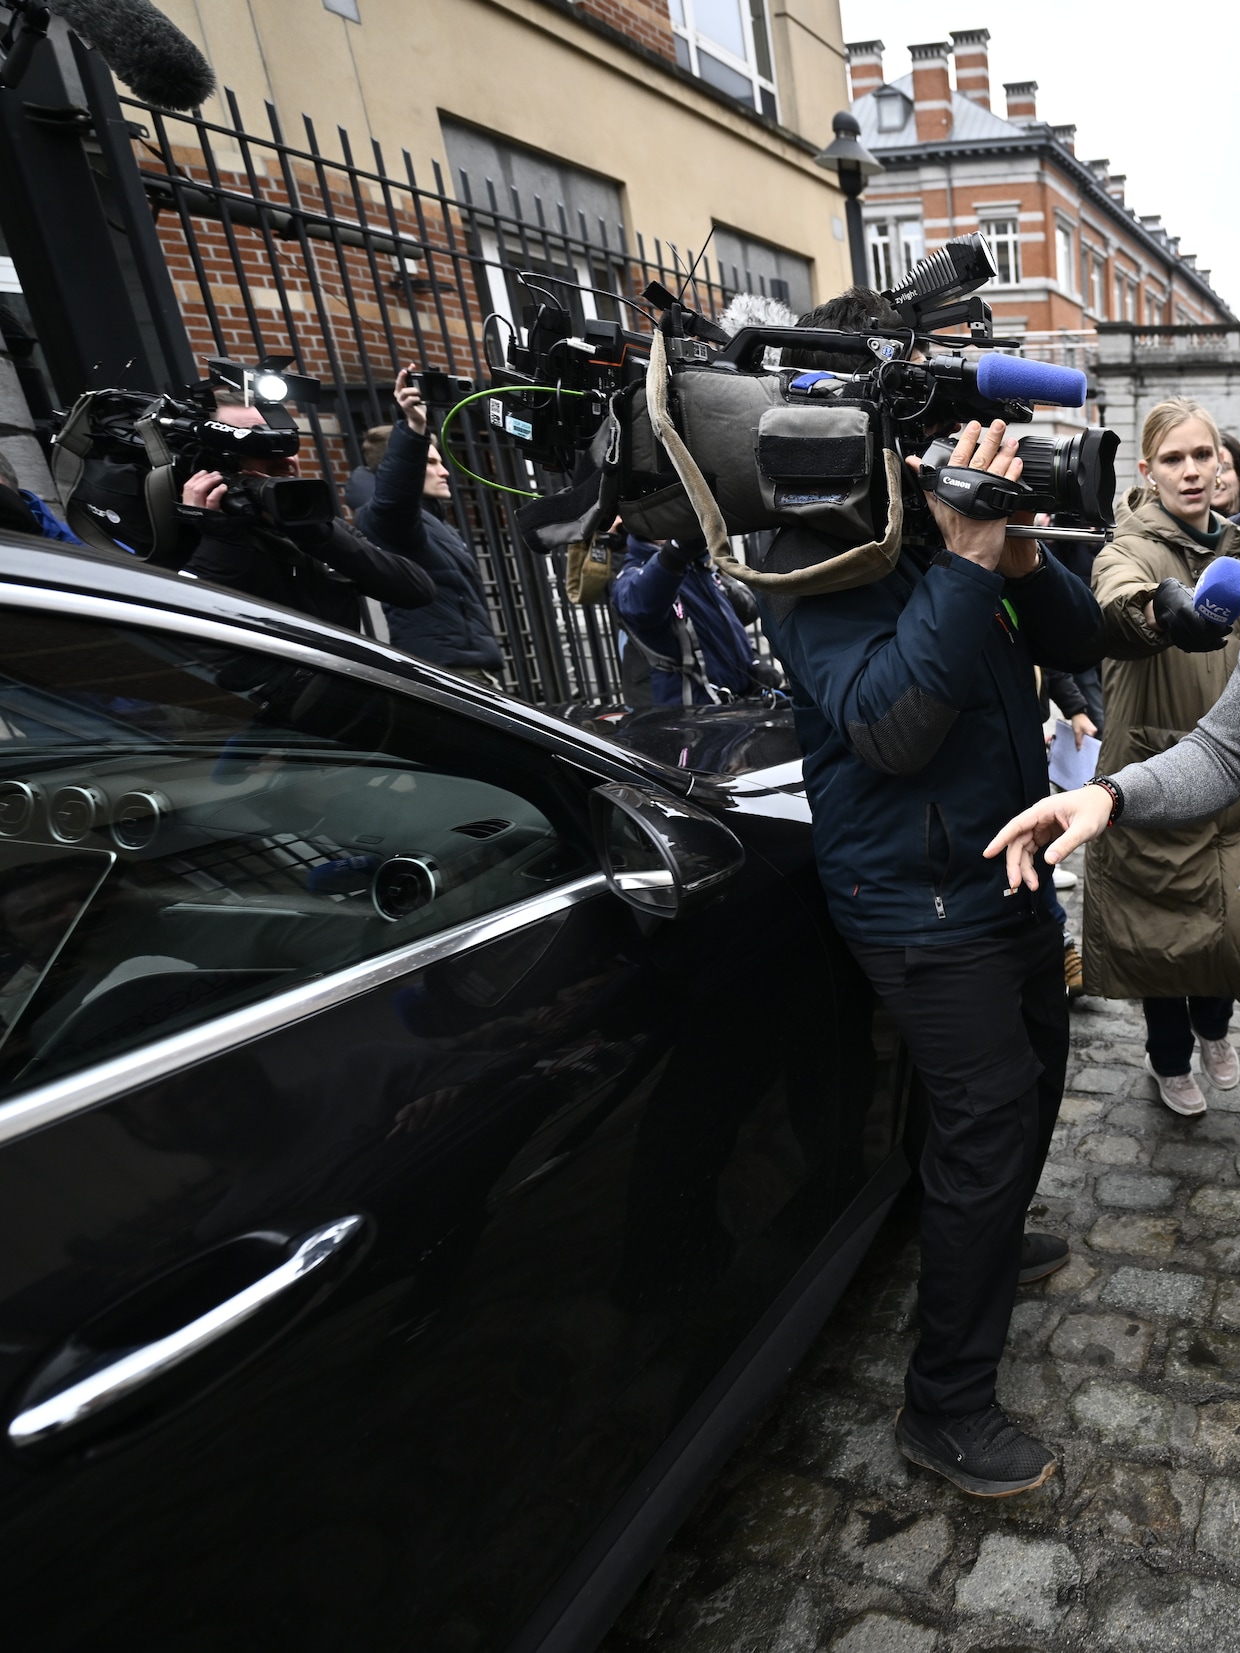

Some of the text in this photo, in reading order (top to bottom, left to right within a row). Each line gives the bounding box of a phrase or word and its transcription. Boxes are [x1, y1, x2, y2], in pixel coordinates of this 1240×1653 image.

[894, 289, 918, 304] zylight
[943, 476, 971, 490] Canon
[1205, 598, 1231, 617] vrt
